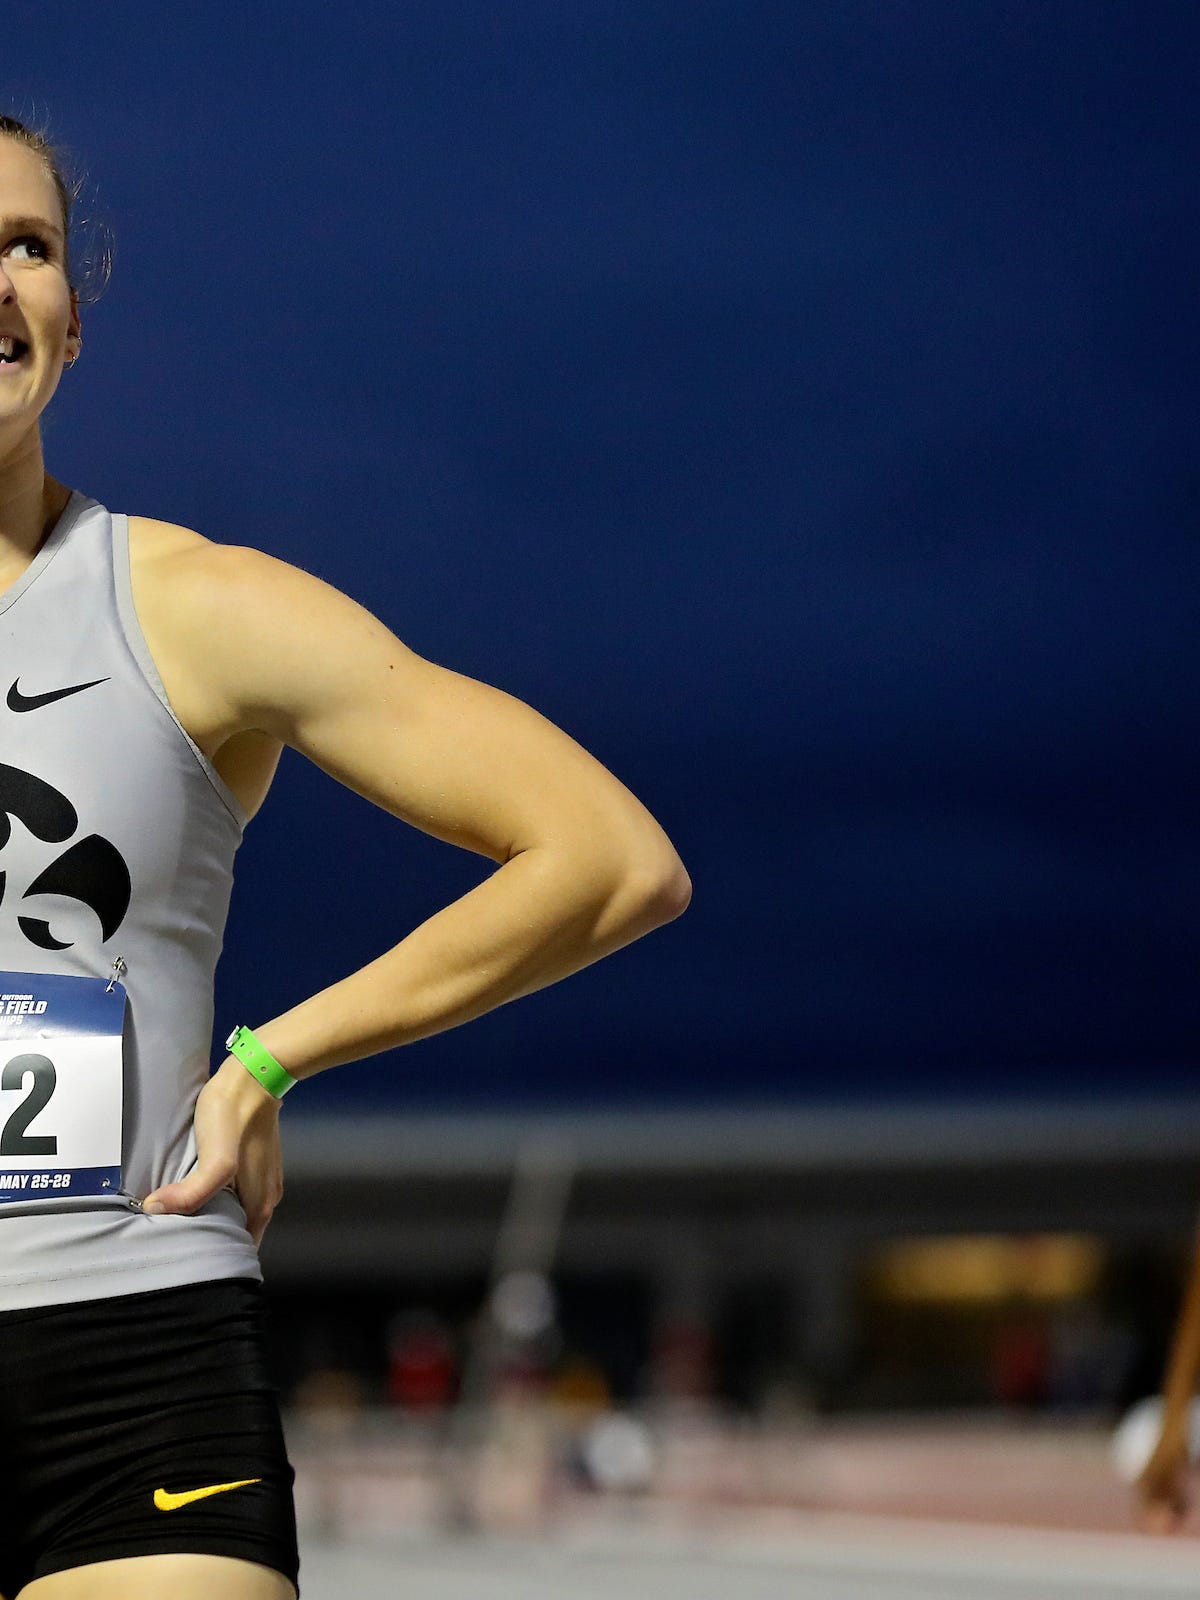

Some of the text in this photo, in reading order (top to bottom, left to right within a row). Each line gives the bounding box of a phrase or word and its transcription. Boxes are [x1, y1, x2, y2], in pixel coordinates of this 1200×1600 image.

[5, 1001, 48, 1014] FIELD
[0, 1175, 30, 1189] MAY
[30, 1174, 71, 1189] 25-28
